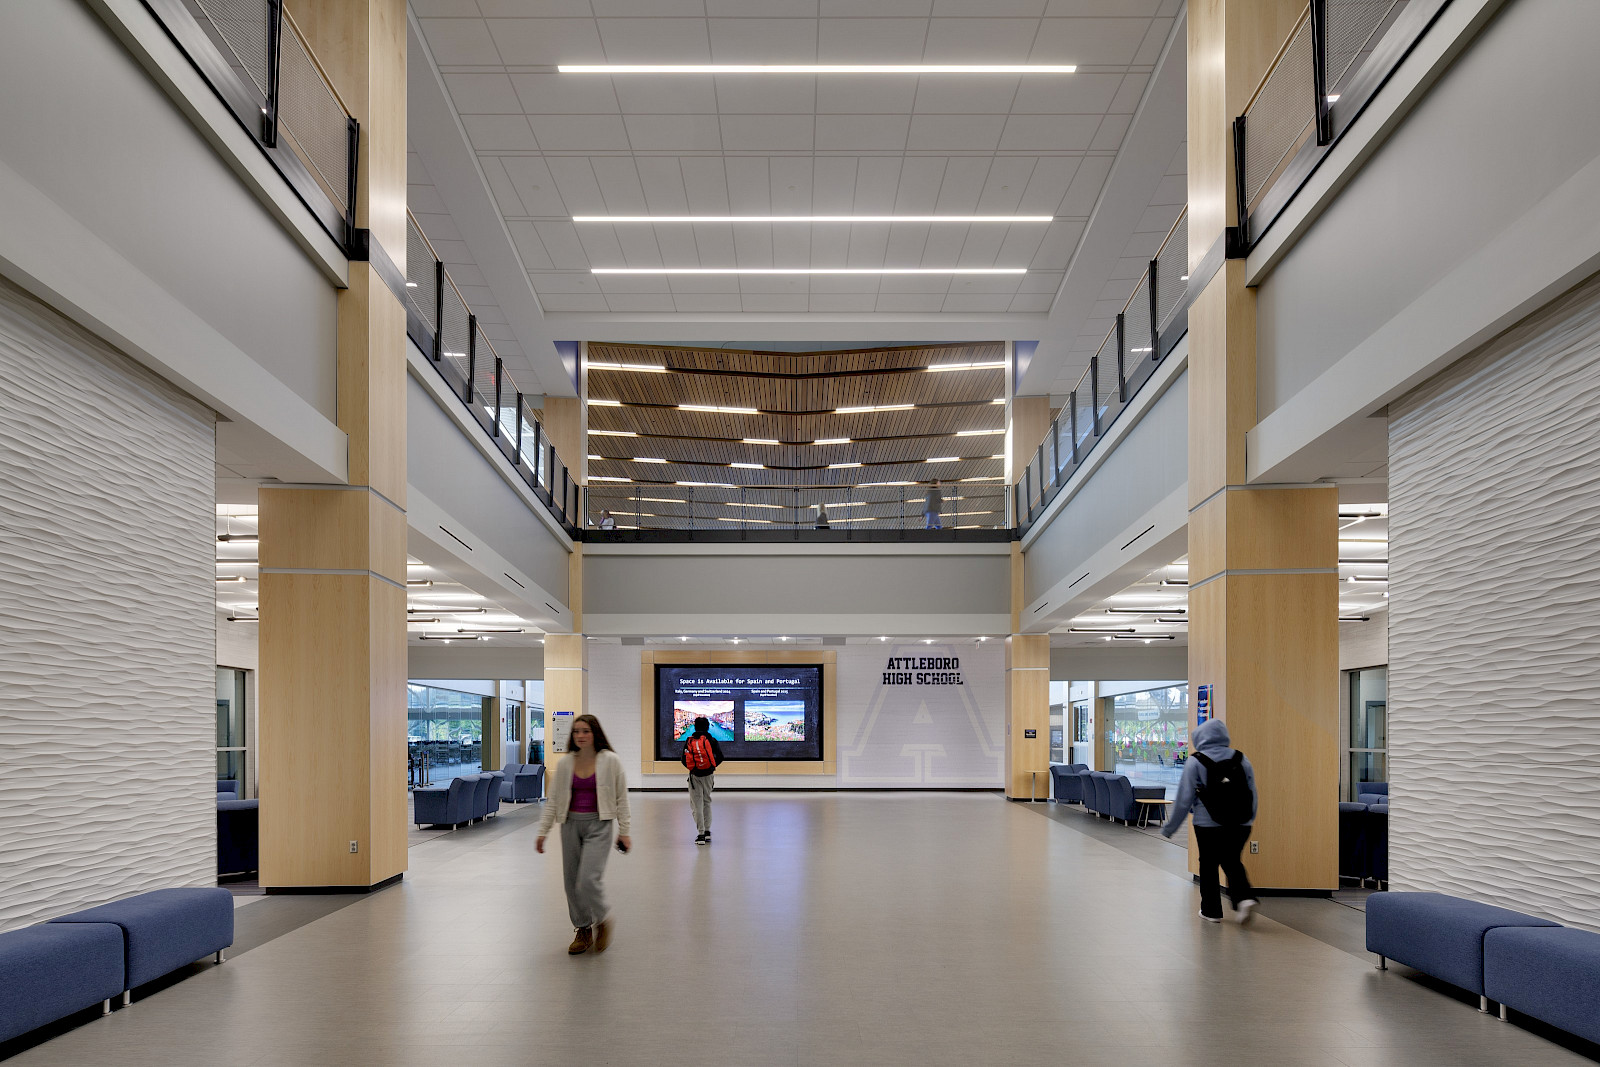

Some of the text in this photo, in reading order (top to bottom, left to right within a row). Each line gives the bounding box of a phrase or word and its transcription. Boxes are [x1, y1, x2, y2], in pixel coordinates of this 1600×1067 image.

[887, 657, 960, 670] ATTLEBORO
[882, 672, 964, 685] HIGH SCHOOL
